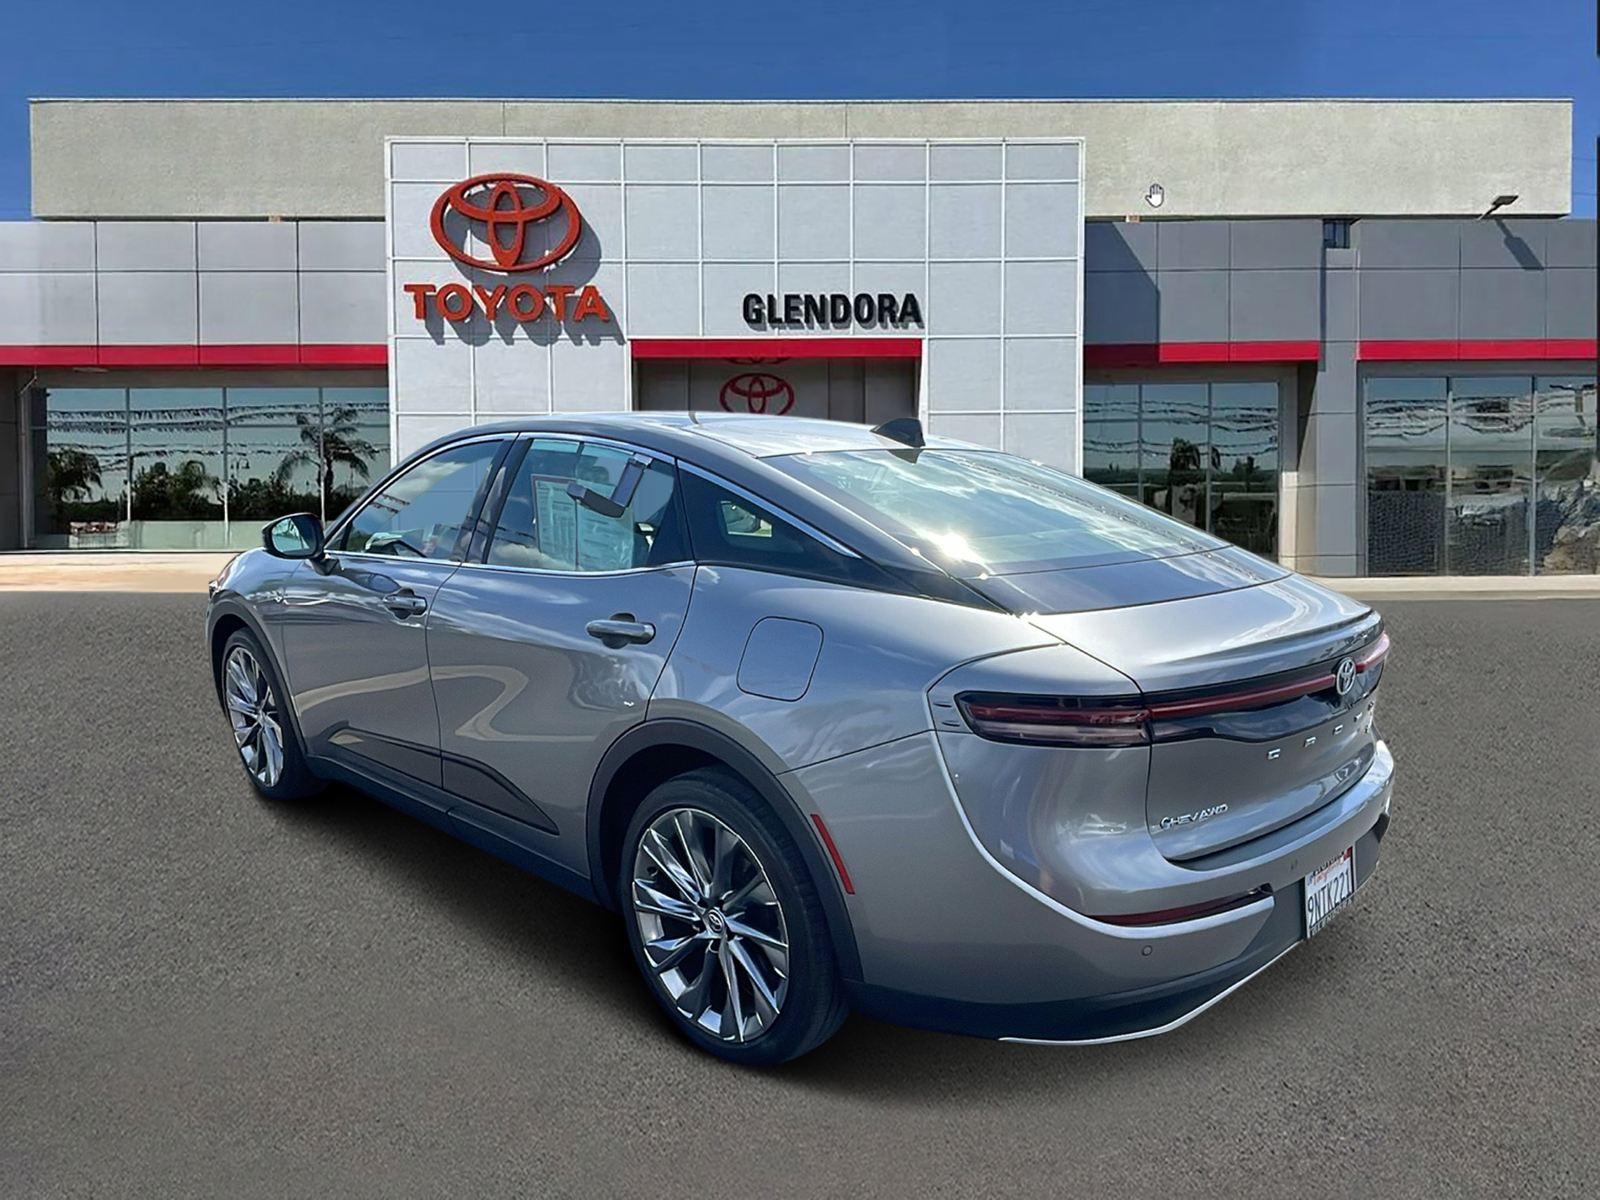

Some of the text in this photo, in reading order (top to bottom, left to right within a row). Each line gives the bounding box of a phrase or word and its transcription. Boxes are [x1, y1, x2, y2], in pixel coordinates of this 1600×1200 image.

[404, 283, 610, 322] TOYOTA
[742, 293, 923, 326] GLENDORA
[1308, 869, 1351, 929] 9NTK221
